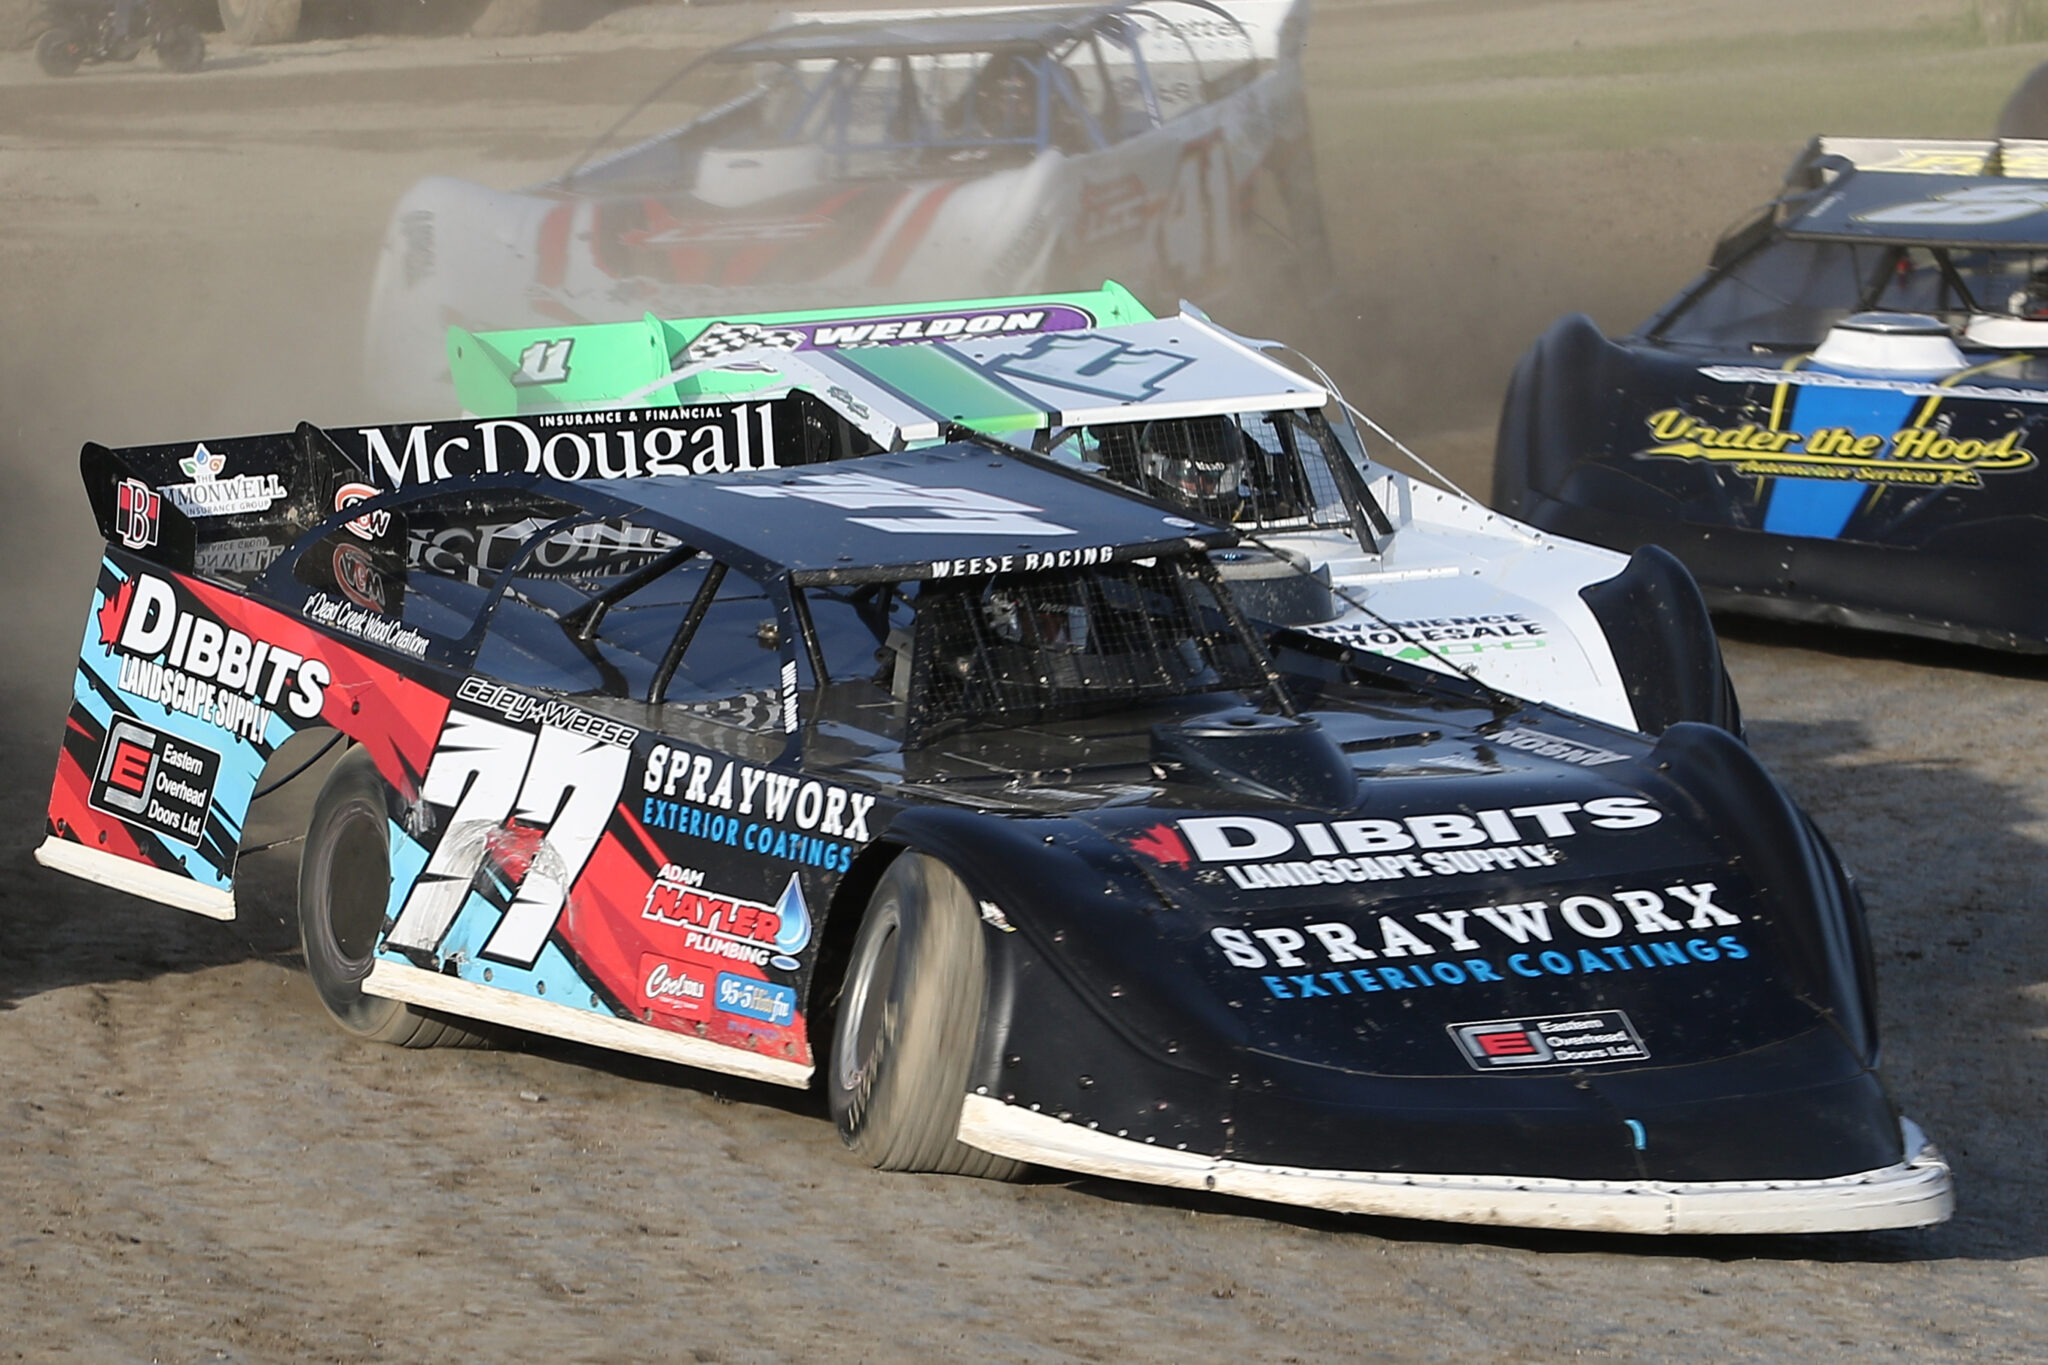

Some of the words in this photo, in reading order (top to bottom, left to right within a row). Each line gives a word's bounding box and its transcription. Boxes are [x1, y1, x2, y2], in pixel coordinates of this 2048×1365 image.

[813, 311, 1045, 345] WELDON
[539, 412, 621, 428] INSURANCE
[628, 411, 639, 422] &
[645, 407, 723, 421] FINANCIAL
[1647, 408, 1799, 451] Under
[1804, 427, 1883, 457] the
[1892, 428, 2020, 461] Hood
[359, 402, 781, 488] McDougall
[197, 474, 214, 483] THE
[186, 503, 236, 516] INSURANCE
[239, 500, 270, 512] GROUP
[931, 554, 1012, 579] WEESE
[1025, 546, 1114, 572] RACING
[313, 592, 339, 621] Dead
[337, 602, 368, 634] Creek
[364, 611, 390, 641] Wood
[387, 620, 429, 655] Creations
[118, 573, 332, 719] DIBBITS
[118, 656, 214, 724] LANDSCAPE
[214, 689, 271, 744] SUPPLY
[162, 743, 203, 776] Eastern
[156, 771, 207, 808] Overhead
[644, 744, 876, 842] SPRAYWORX
[148, 799, 181, 828] Doors
[180, 812, 201, 837] Ltd.
[386, 709, 631, 962] 77
[643, 798, 738, 846] EXTERIOR
[743, 823, 853, 873] COATINGS
[1176, 796, 1664, 862] DIBBITS
[657, 863, 705, 887] ADAM
[1223, 852, 1435, 890] LANDSCAPE
[1426, 843, 1557, 878] SUPPLY
[649, 884, 781, 944] NAYLER
[1211, 883, 1741, 969] SPRAYWORX
[685, 933, 769, 966] PLUMBING
[1262, 958, 1505, 1000] EXTERIOR
[1507, 935, 1750, 979] COATINGS
[1537, 1019, 1604, 1033] Eastern
[1546, 1031, 1628, 1047] Overhead
[1554, 1050, 1607, 1061] Doors
